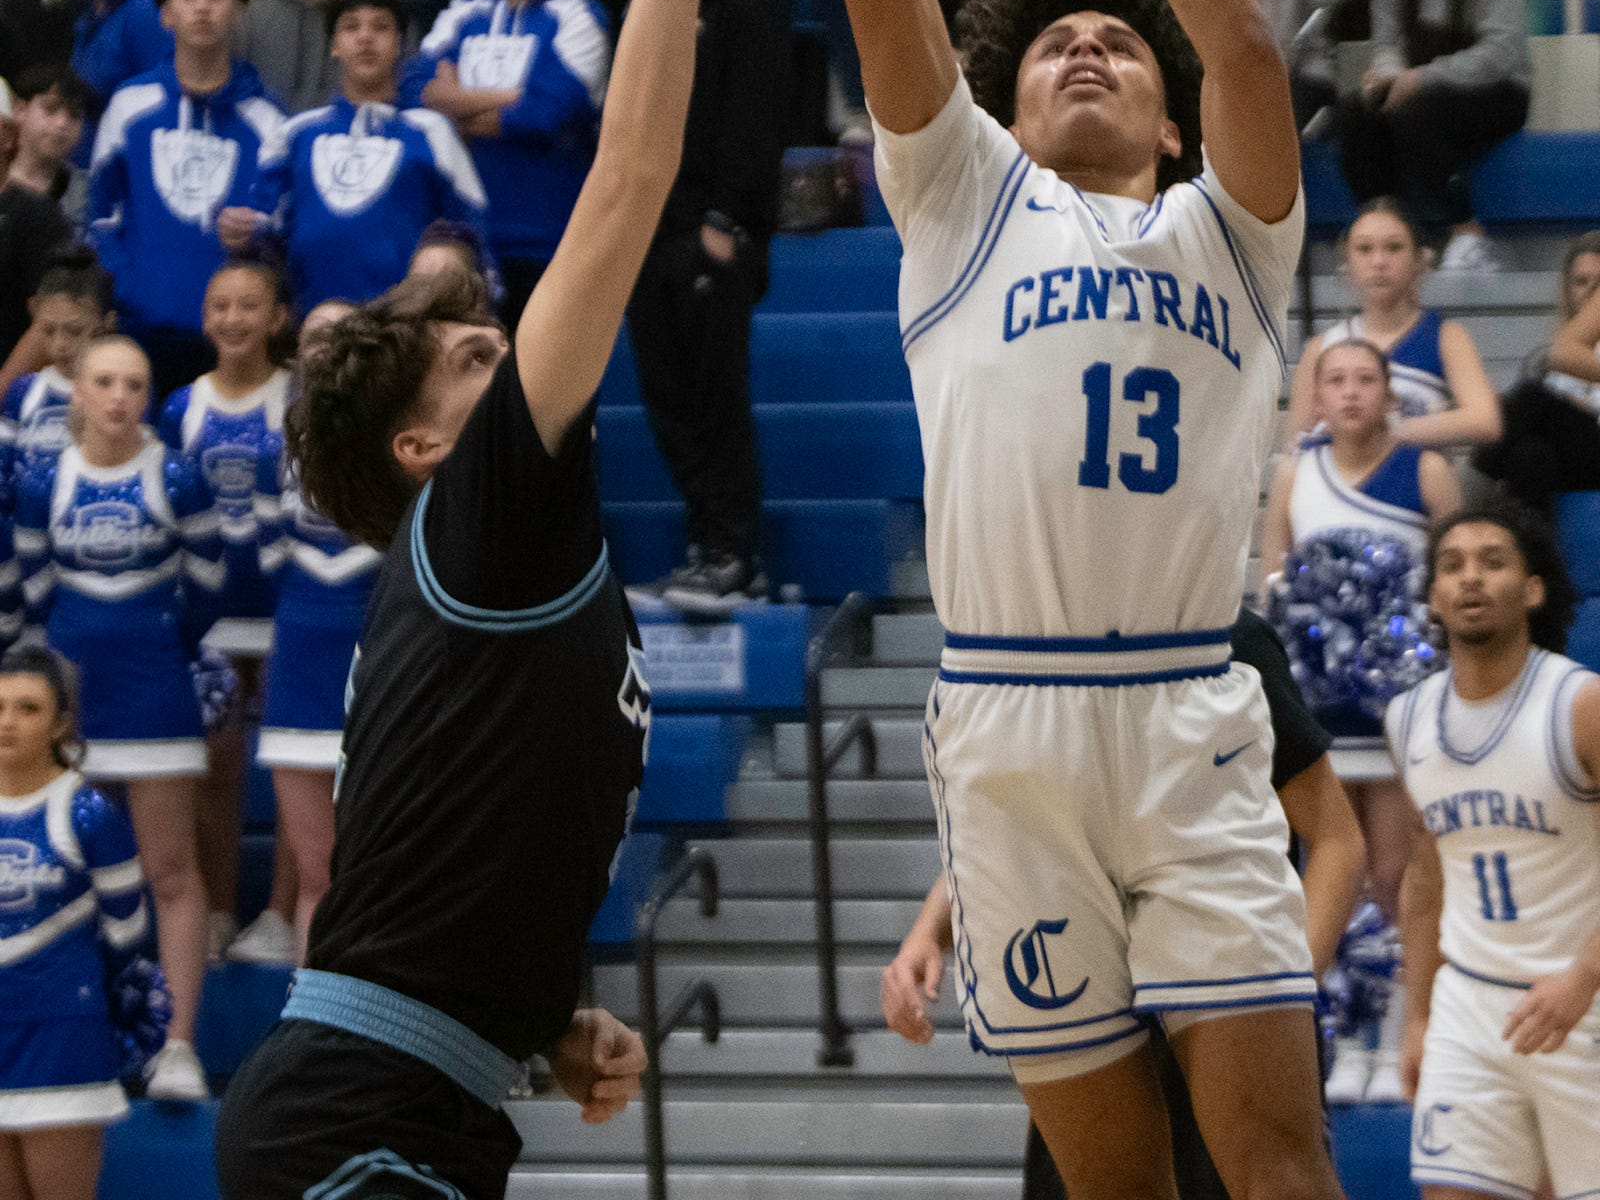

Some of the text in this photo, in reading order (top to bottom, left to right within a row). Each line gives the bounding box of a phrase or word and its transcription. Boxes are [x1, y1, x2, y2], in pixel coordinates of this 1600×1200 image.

[1003, 265, 1241, 371] CENTRAL
[1078, 361, 1180, 494] 13
[1472, 851, 1518, 921] 11
[1003, 918, 1090, 1010] C
